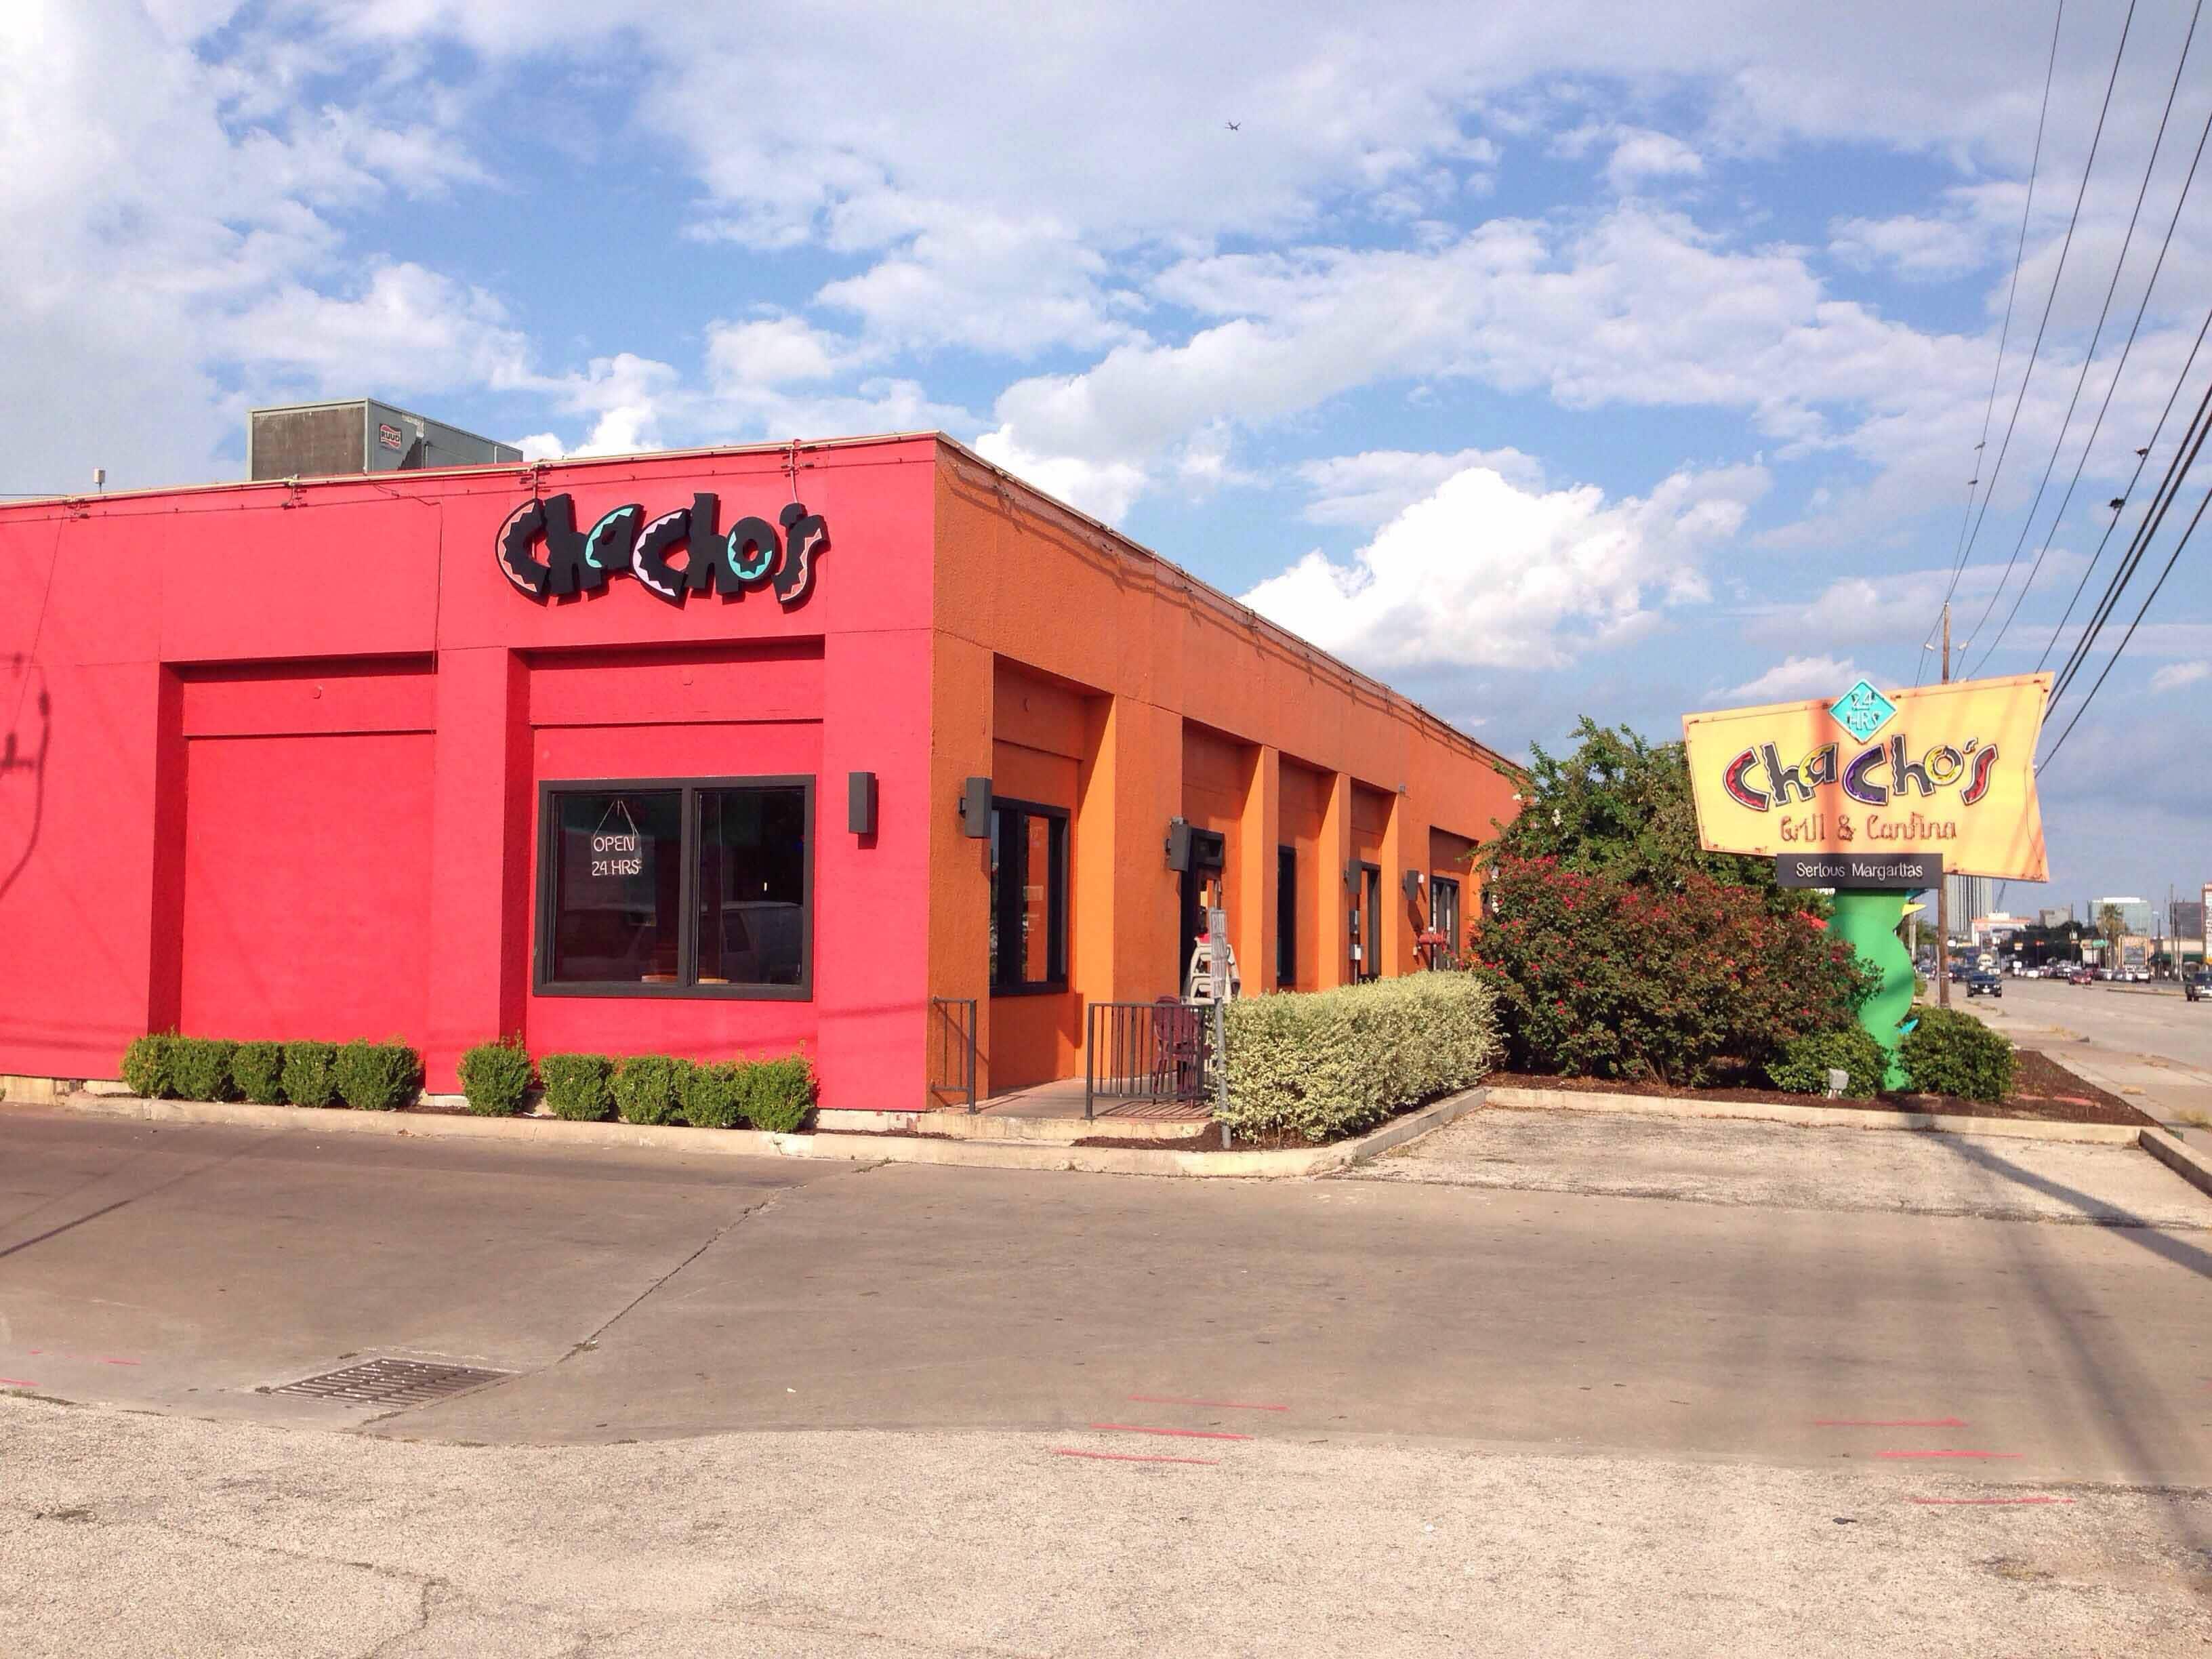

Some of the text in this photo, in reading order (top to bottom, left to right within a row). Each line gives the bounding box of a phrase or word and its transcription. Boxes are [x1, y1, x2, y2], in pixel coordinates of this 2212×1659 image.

[380, 430, 400, 442] RUUD
[1851, 691, 1876, 710] 24
[1847, 710, 1881, 731] HRS
[1780, 812, 1957, 842] Grill & Cantina
[593, 836, 635, 852] OPEN
[592, 859, 641, 876] 24 HRS
[1796, 861, 1923, 881] Serious Margaritas
